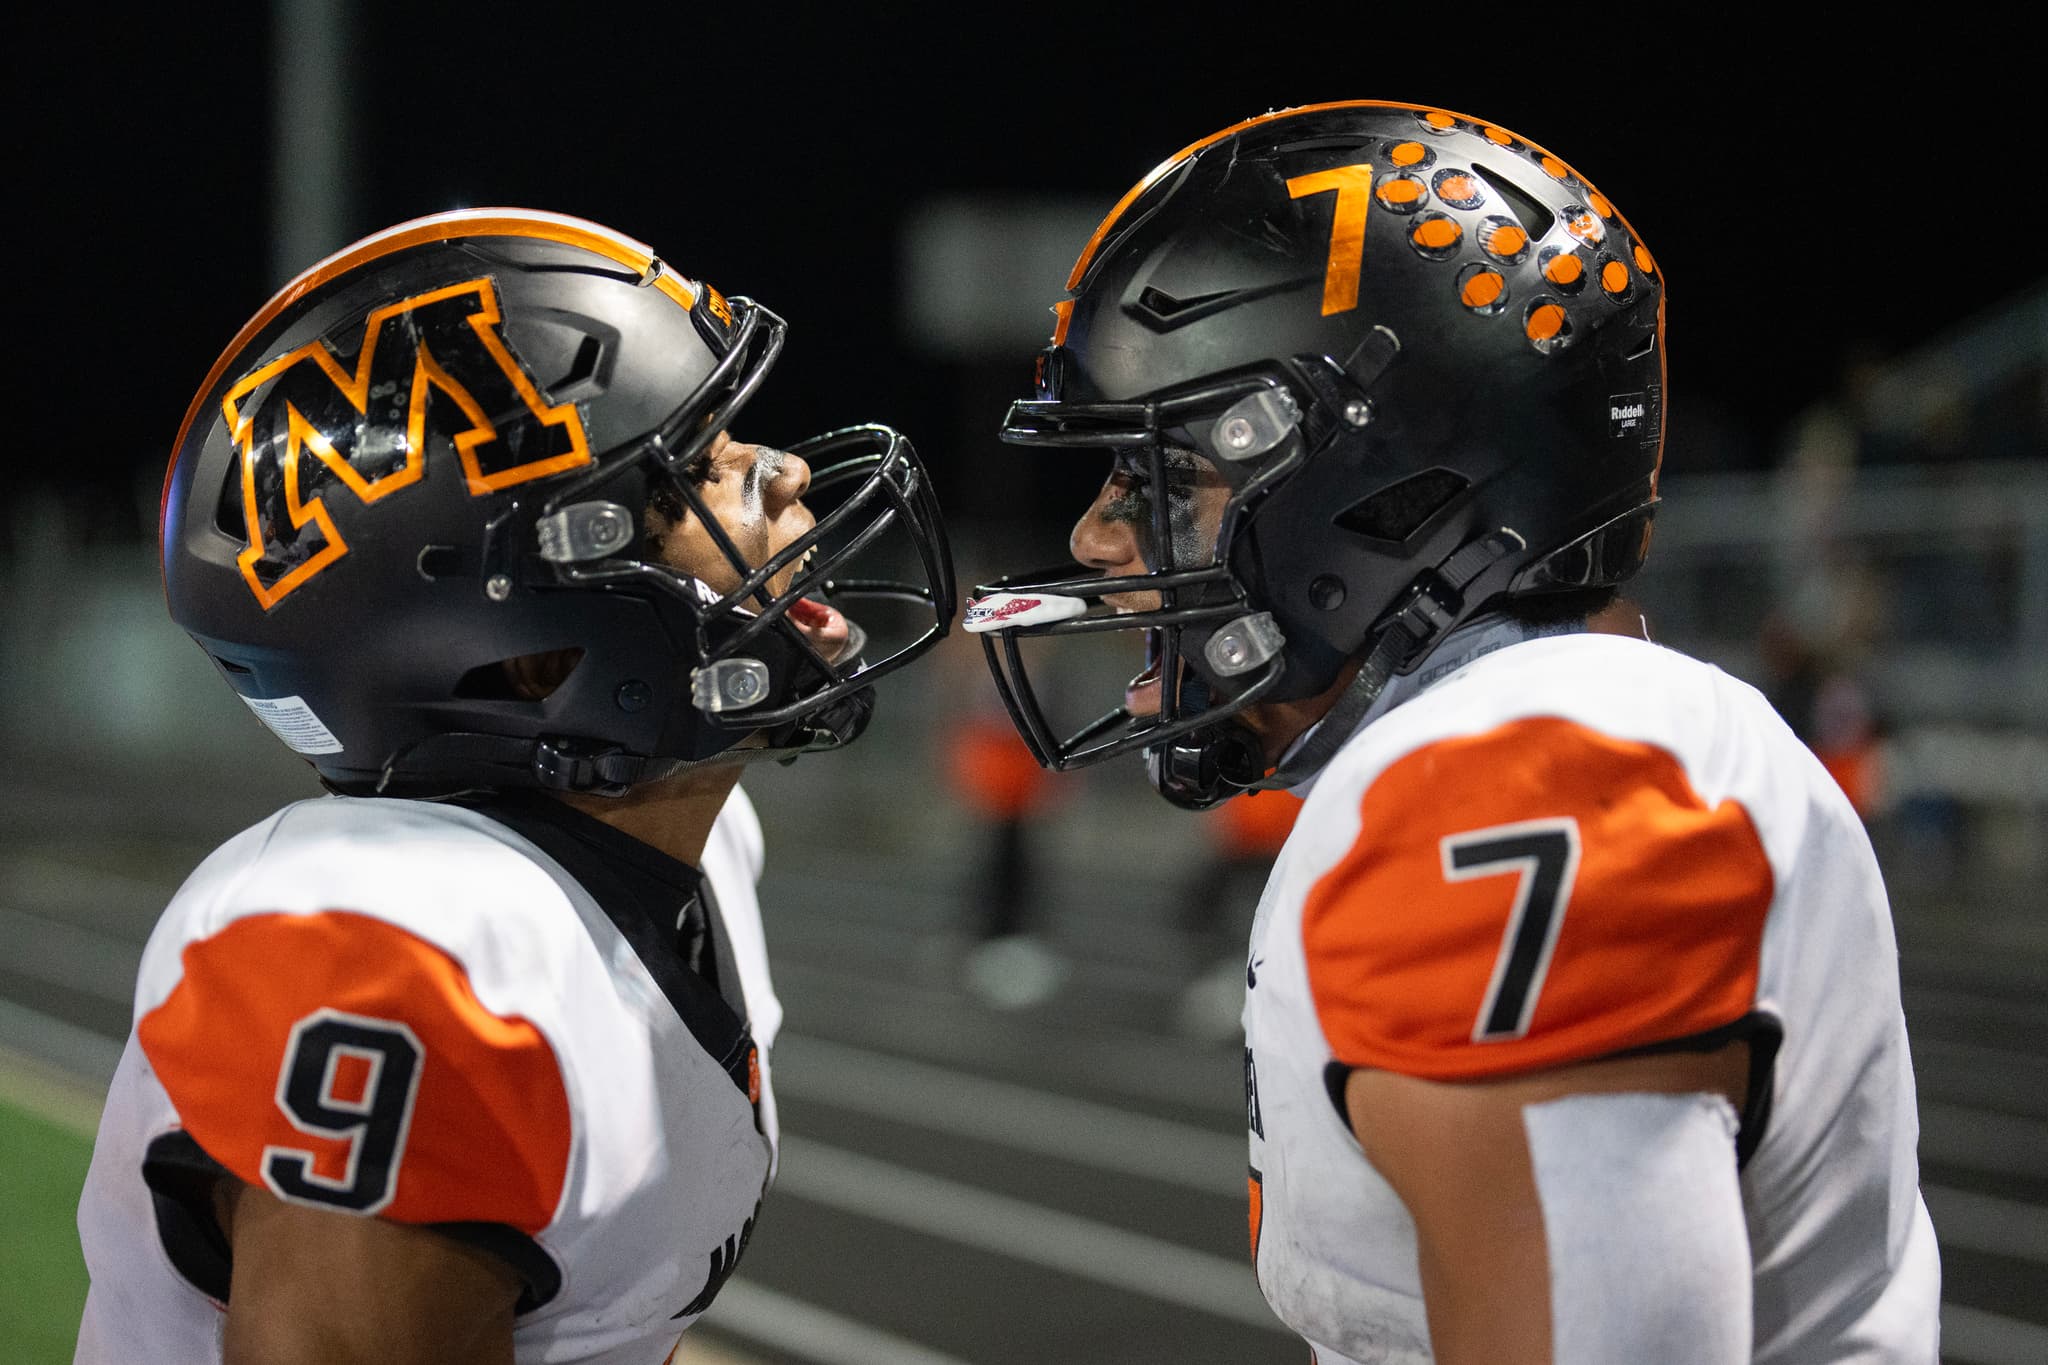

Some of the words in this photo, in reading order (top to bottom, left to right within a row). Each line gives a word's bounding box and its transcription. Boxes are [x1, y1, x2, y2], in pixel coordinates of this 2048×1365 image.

[1286, 164, 1373, 317] 7
[222, 277, 591, 611] M
[1611, 404, 1643, 420] Riddell
[1621, 419, 1637, 428] LARGE
[1440, 816, 1582, 1043] 7
[260, 1006, 426, 1216] 9
